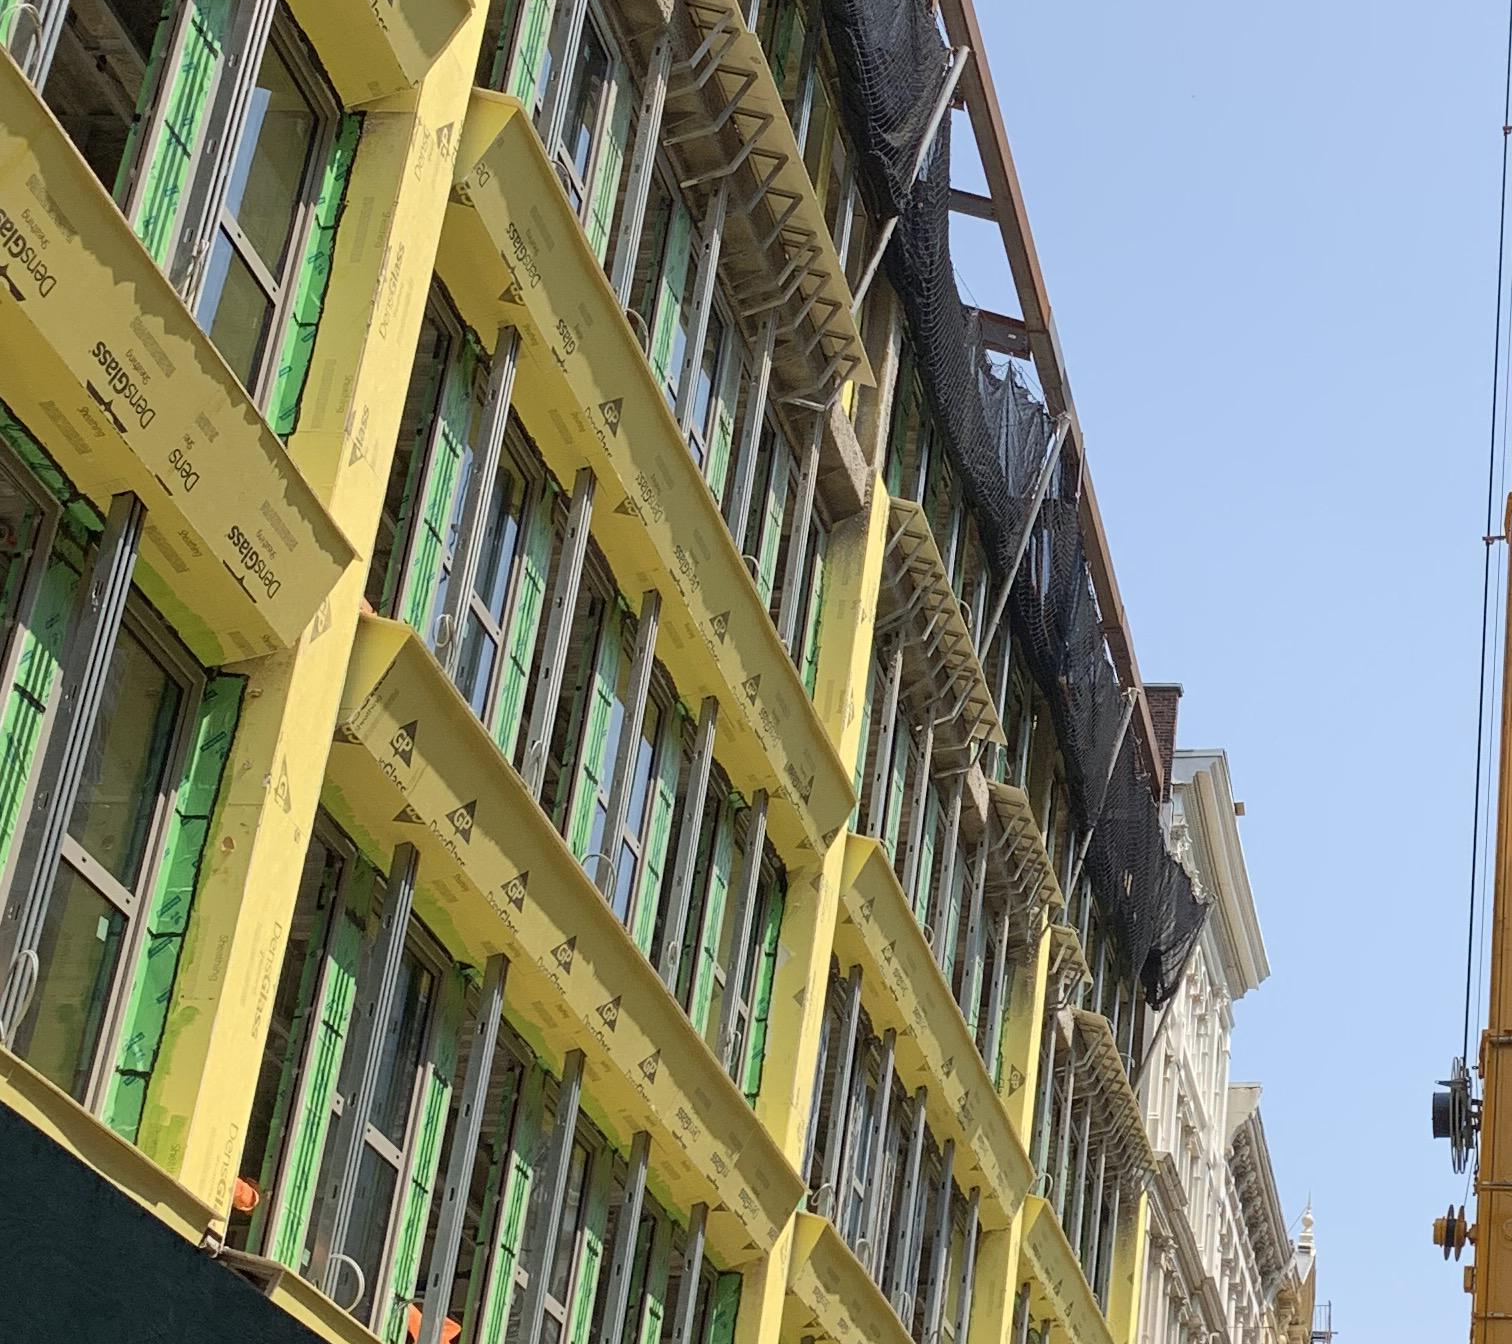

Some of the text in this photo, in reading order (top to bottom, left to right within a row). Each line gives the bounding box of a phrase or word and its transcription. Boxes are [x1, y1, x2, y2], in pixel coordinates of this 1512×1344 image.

[475, 162, 490, 188] De
[21, 208, 50, 250] Sheathing
[506, 221, 542, 289] DensGlass
[556, 318, 577, 355] Glass
[125, 348, 151, 386] Sheathing
[92, 341, 156, 430] DensGlass
[604, 402, 620, 423] GP
[169, 448, 200, 492] Dens
[227, 525, 281, 599] DensGlass
[393, 729, 412, 752] GP
[453, 808, 472, 830] GP
[507, 879, 524, 900] GP
[208, 934, 229, 982] Sheathing
[556, 944, 573, 964] GP
[603, 1003, 617, 1022] GP
[1011, 1070, 1021, 1090] GP
